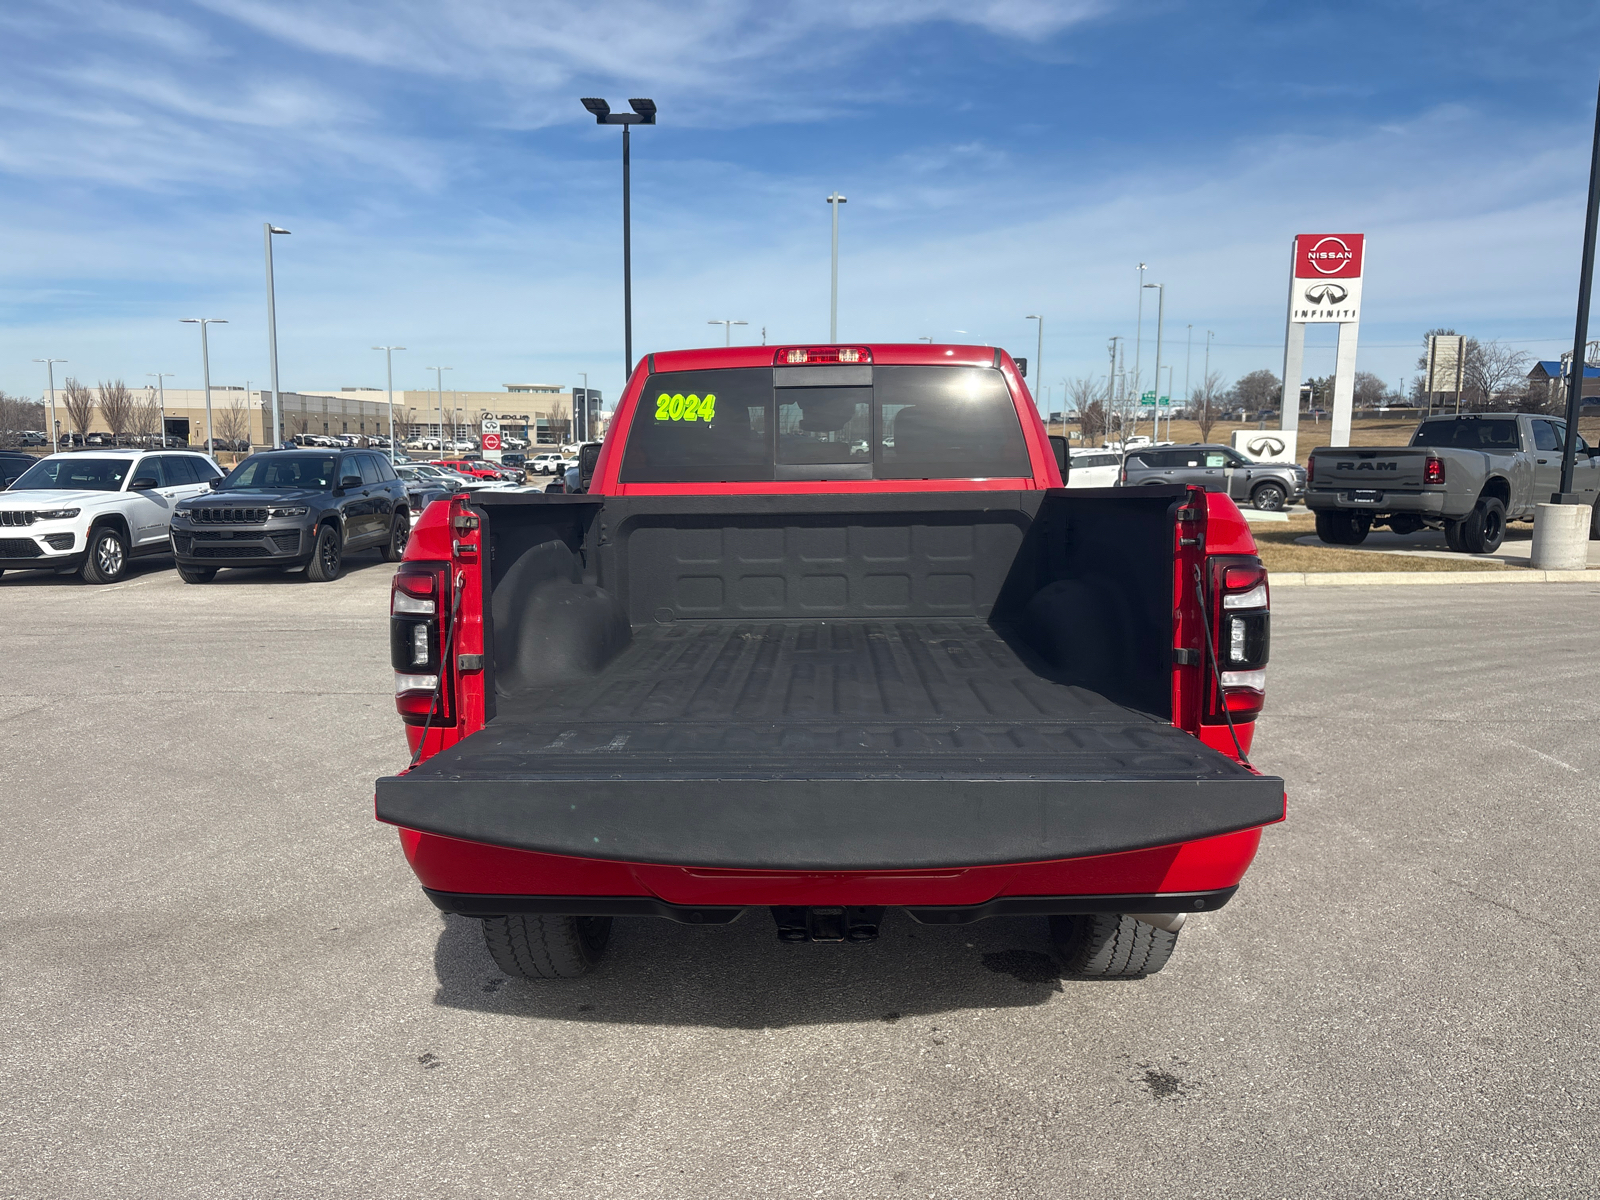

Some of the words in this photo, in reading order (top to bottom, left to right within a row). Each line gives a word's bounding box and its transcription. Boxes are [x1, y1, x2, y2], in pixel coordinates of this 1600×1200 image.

[1294, 309, 1356, 318] INFINITI
[654, 393, 716, 422] 2024
[1336, 462, 1397, 470] RAM
